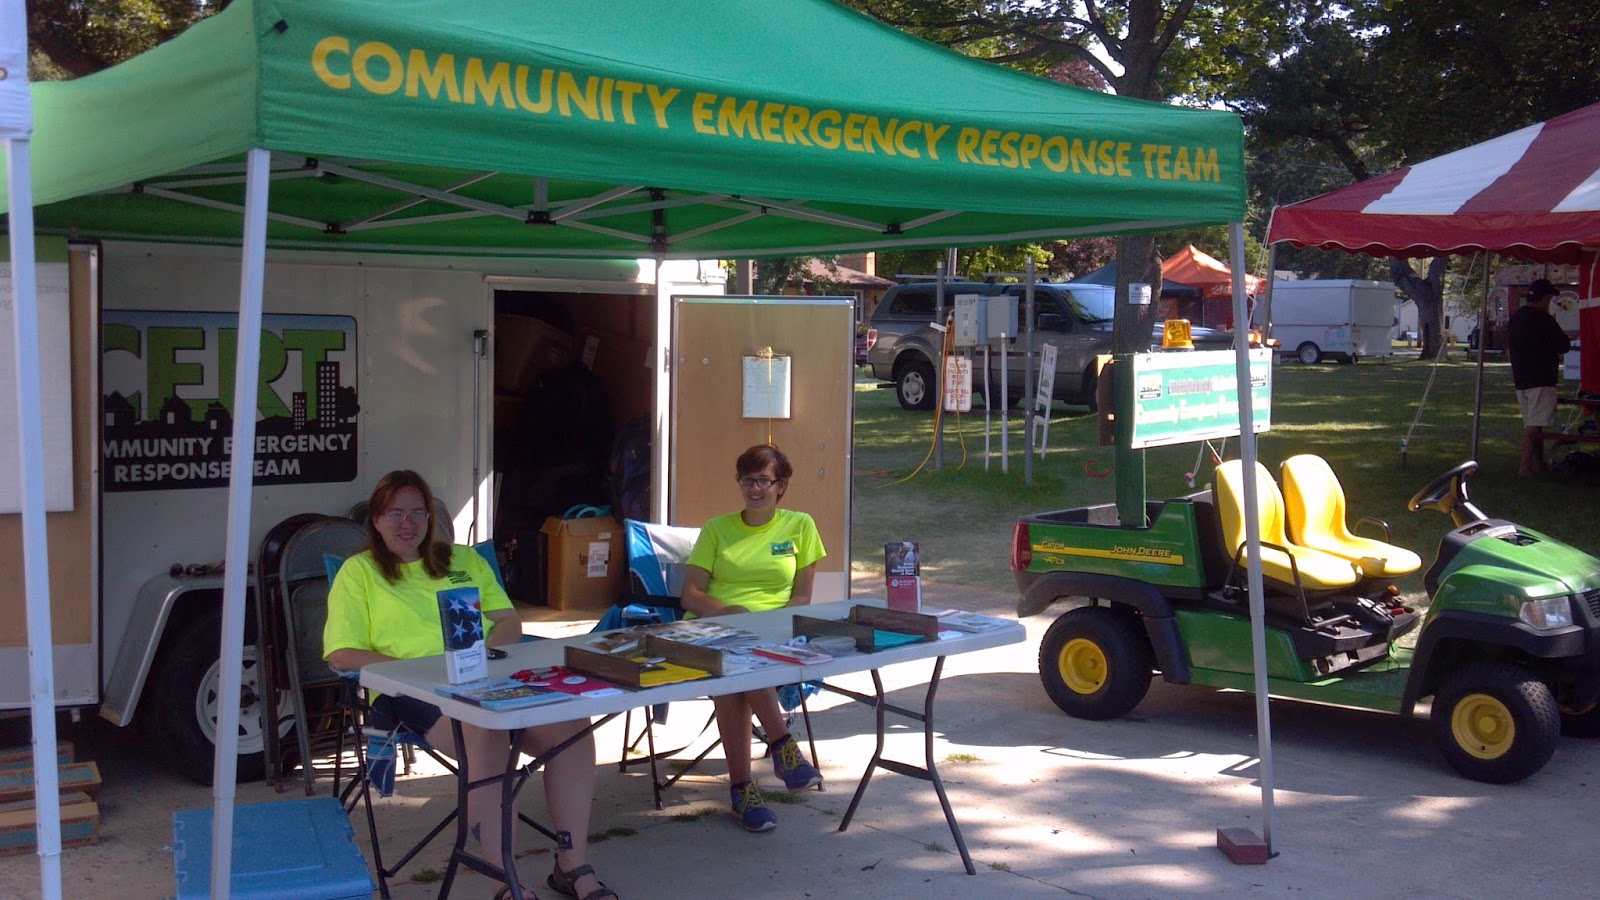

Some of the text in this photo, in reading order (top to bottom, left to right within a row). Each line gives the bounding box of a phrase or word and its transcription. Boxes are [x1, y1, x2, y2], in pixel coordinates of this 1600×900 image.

[311, 36, 1221, 183] COMMUNITY EMERGENCY RESPONSE TEAM
[103, 323, 346, 422] CERT
[103, 432, 352, 458] MMUNITY EERGENCY
[114, 459, 301, 483] RESPONSE EAM
[1110, 544, 1137, 556] JOHN
[1137, 546, 1172, 558] DEERE
